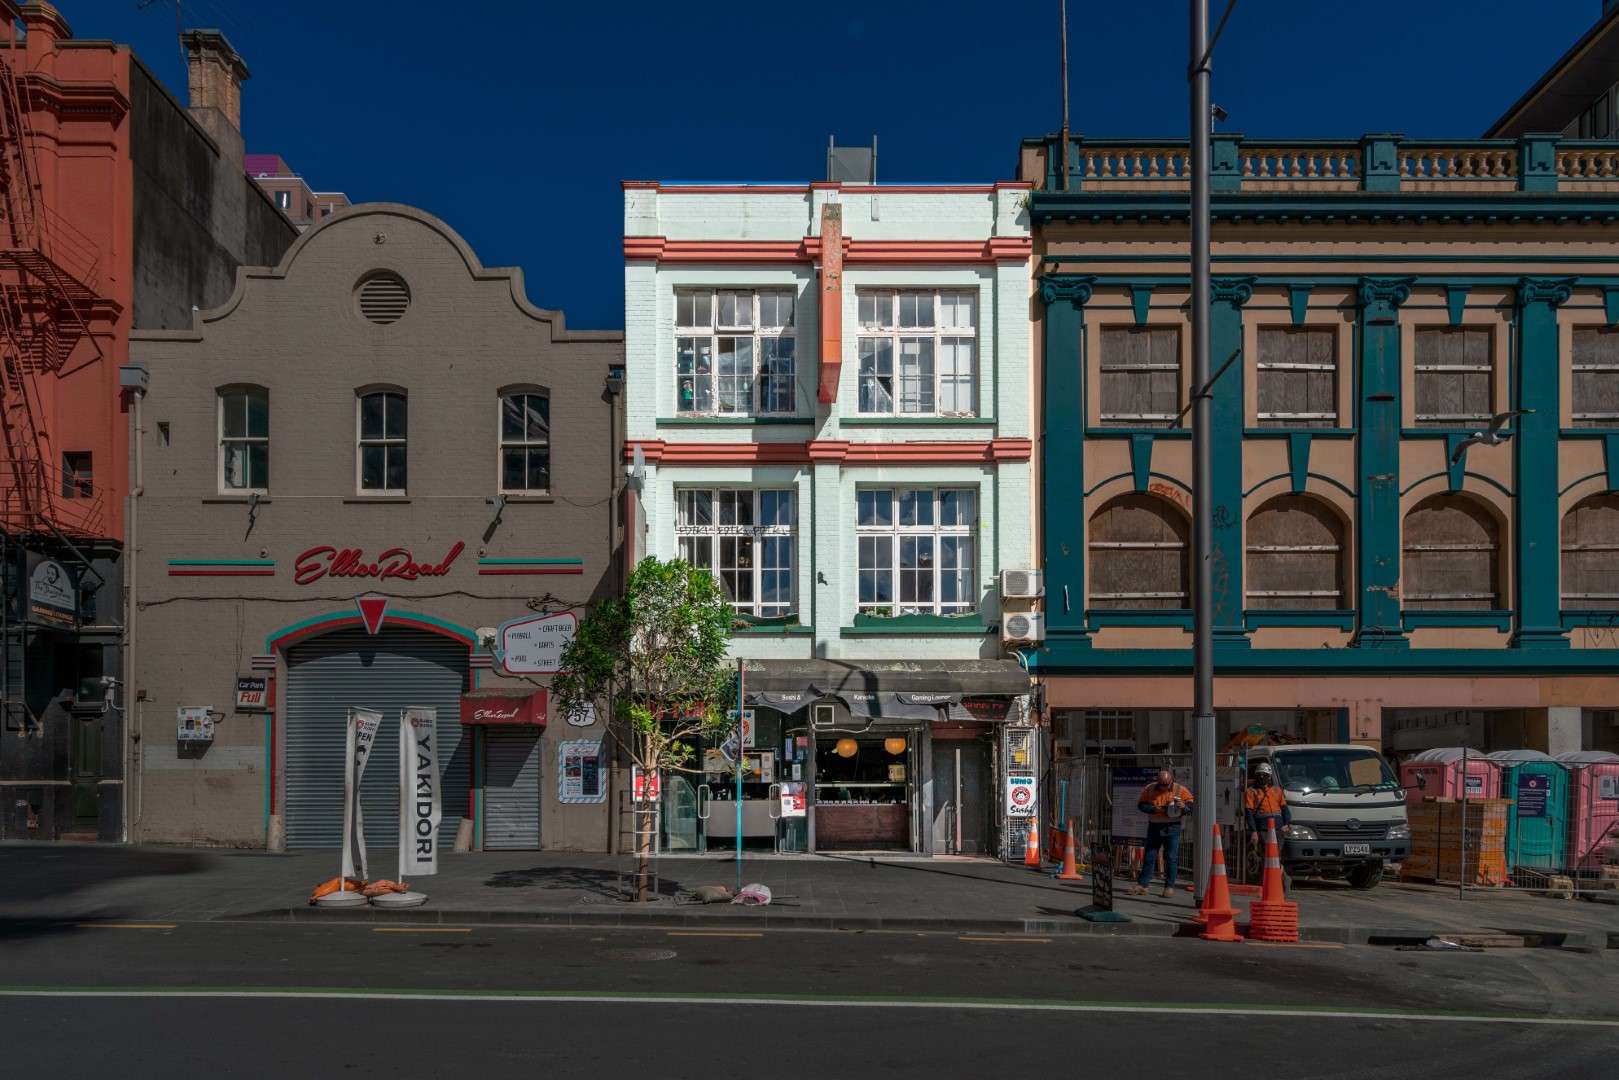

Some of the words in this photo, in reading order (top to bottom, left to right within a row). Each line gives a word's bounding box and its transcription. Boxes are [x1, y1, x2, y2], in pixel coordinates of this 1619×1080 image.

[377, 542, 465, 581] Road
[542, 624, 557, 633] CRAFT
[557, 624, 572, 632] BEER
[537, 659, 557, 667] STREET
[240, 692, 261, 703] Full
[574, 710, 589, 722] 57
[356, 731, 373, 742] PEN
[417, 735, 432, 862] YAKIDORI
[1010, 804, 1034, 814] Sushi
